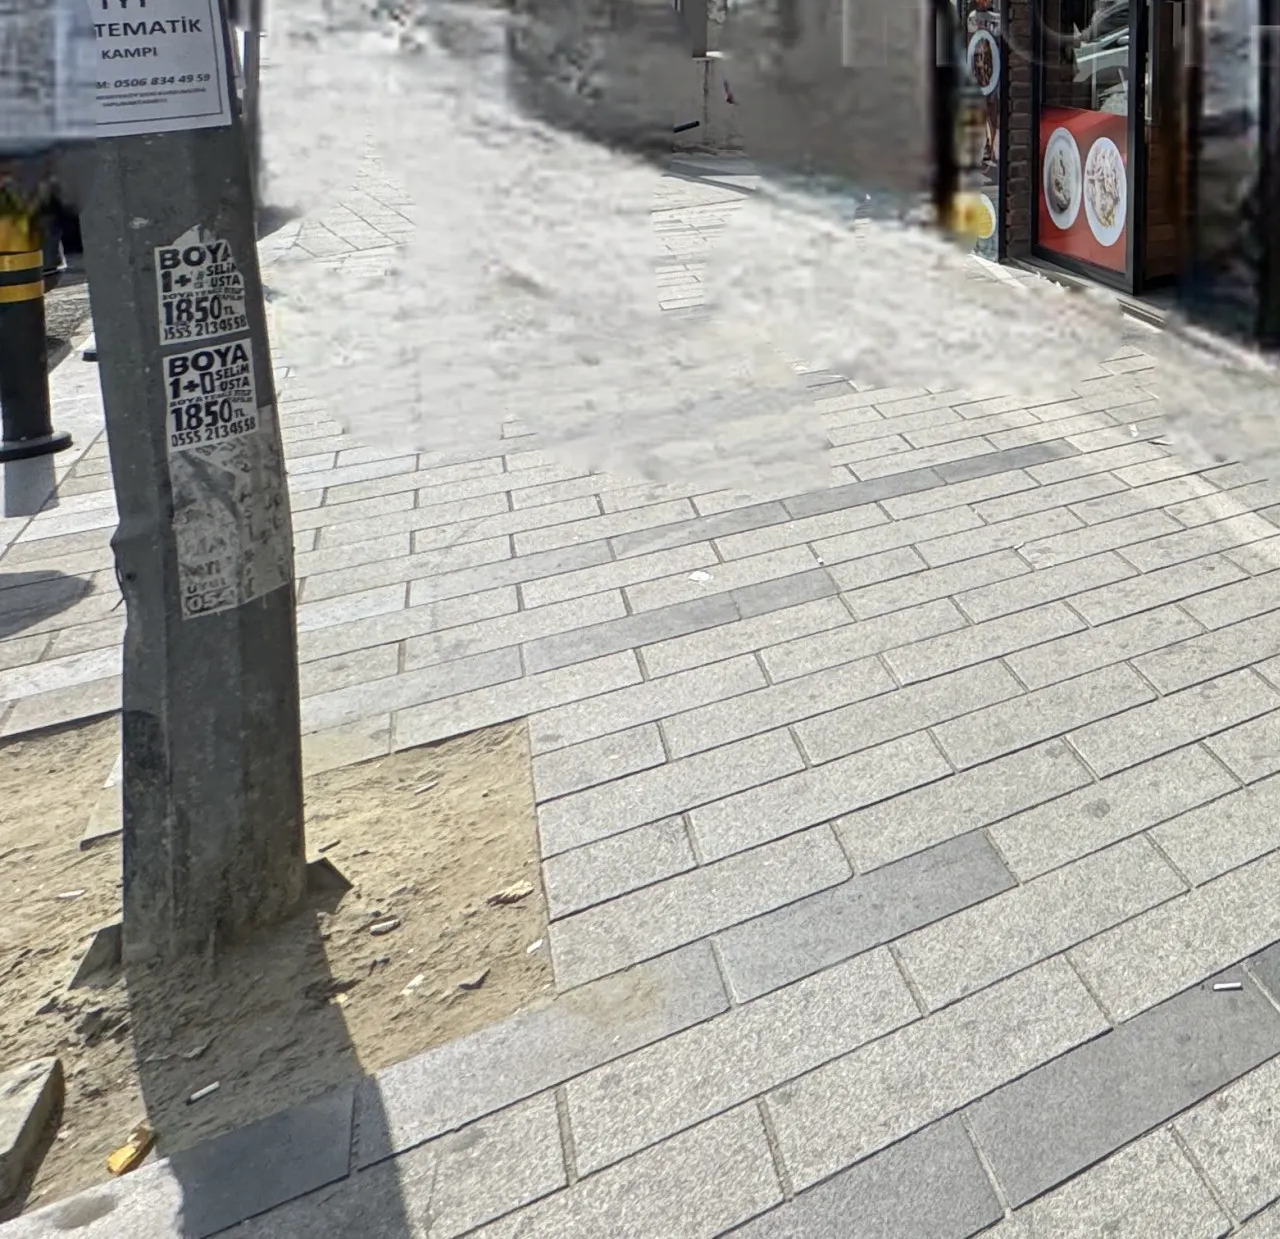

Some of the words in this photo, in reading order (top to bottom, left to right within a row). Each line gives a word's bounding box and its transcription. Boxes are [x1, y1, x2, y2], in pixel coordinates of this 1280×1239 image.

[95, 16, 202, 38] TEMATİK
[102, 47, 158, 59] KAMPI
[114, 78, 147, 88] 0506
[151, 76, 175, 85] 834
[178, 74, 193, 82] 49
[197, 73, 211, 81] 59
[211, 275, 240, 287] USTA
[163, 295, 222, 325] 1850
[169, 343, 249, 377] BOYA
[220, 377, 249, 391] USTA
[171, 398, 232, 432] 1850
[171, 430, 201, 447] 0555
[205, 416, 255, 441] 2134558
